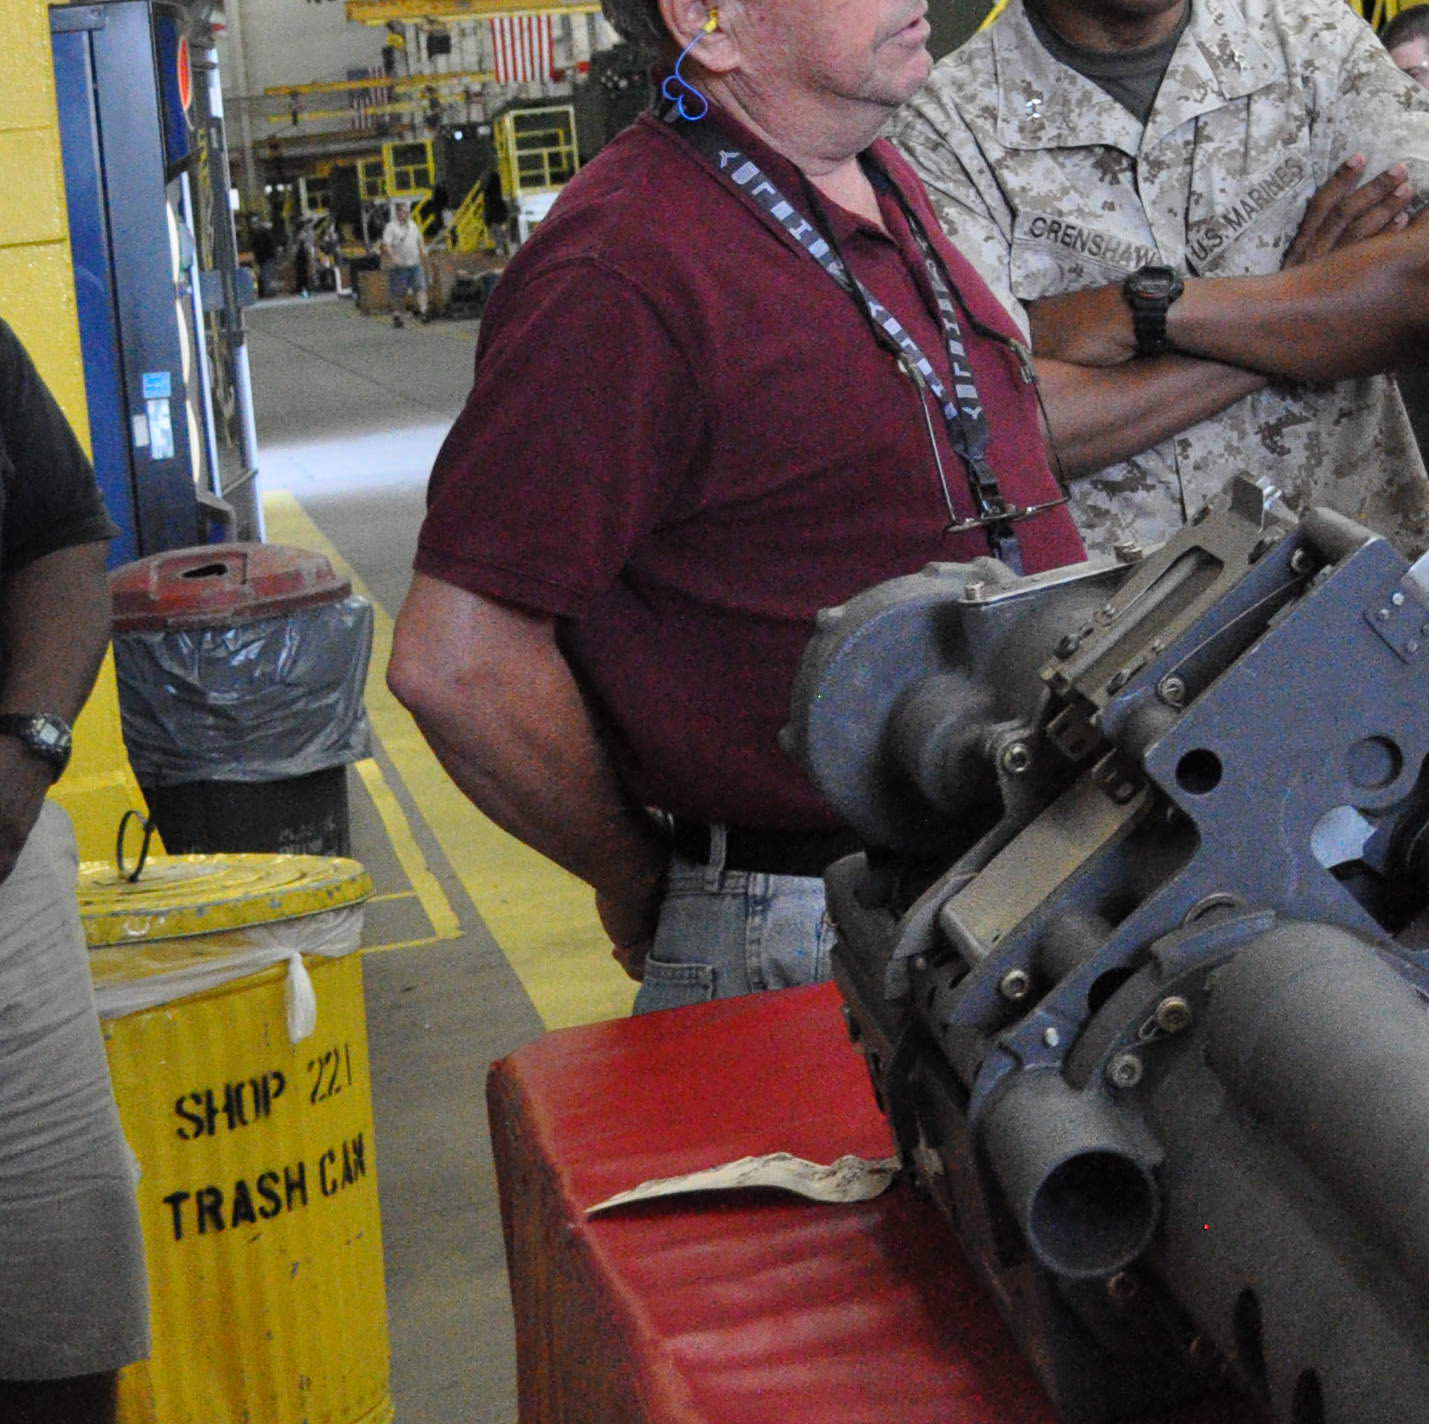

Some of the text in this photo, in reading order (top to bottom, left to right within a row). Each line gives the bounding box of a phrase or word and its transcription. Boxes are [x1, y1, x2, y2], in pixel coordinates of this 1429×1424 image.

[1028, 216, 1156, 268] CRENSHAW
[1190, 155, 1304, 263] U.S. MARINES
[174, 1042, 353, 1141] SHOP 221
[162, 1131, 367, 1242] TRASH CAN
